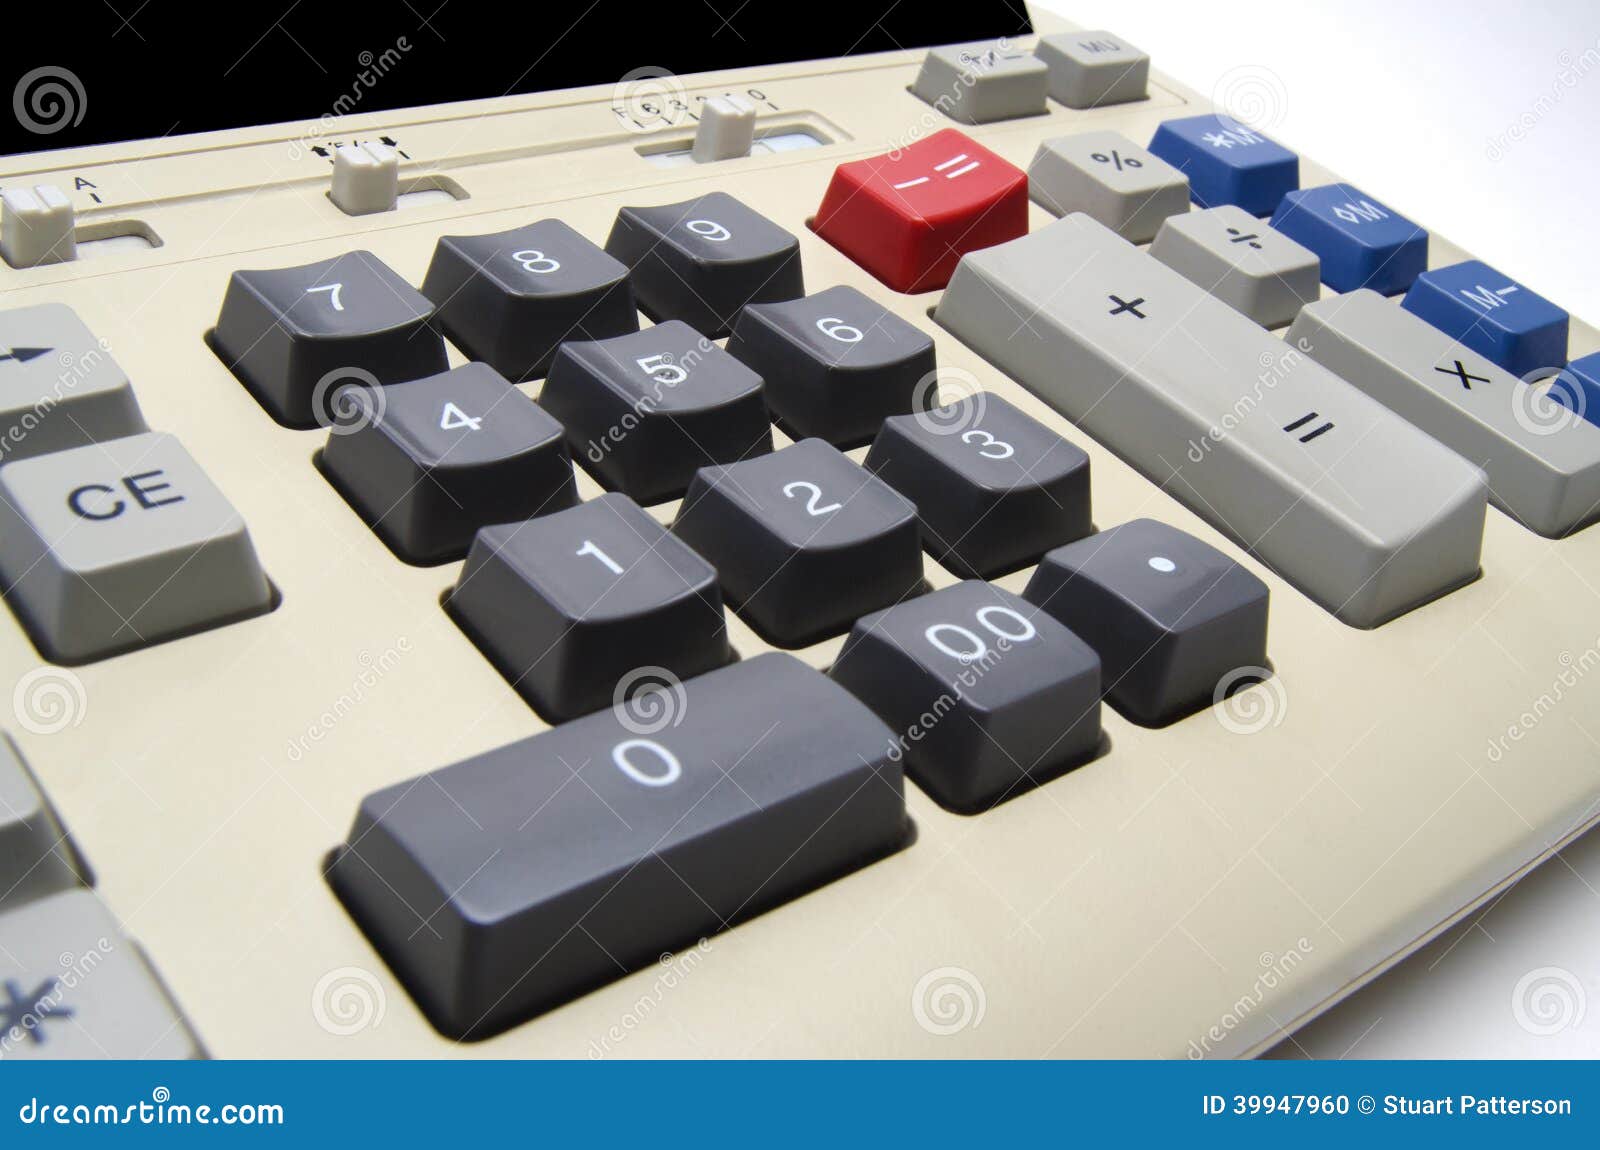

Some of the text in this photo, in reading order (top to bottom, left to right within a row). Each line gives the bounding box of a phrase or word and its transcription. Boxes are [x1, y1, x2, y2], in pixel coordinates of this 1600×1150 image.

[1090, 149, 1144, 171] %
[74, 176, 97, 191] A
[685, 218, 732, 243] 9
[511, 248, 561, 274] 8
[306, 282, 346, 312] 7
[815, 316, 864, 344] 6
[635, 354, 688, 386] 5
[438, 401, 483, 431] 4
[961, 429, 1015, 460] 3
[66, 468, 186, 522] CE
[782, 480, 843, 517] 2
[576, 539, 625, 575] 1
[924, 604, 1037, 662] 00
[611, 738, 683, 788] 0
